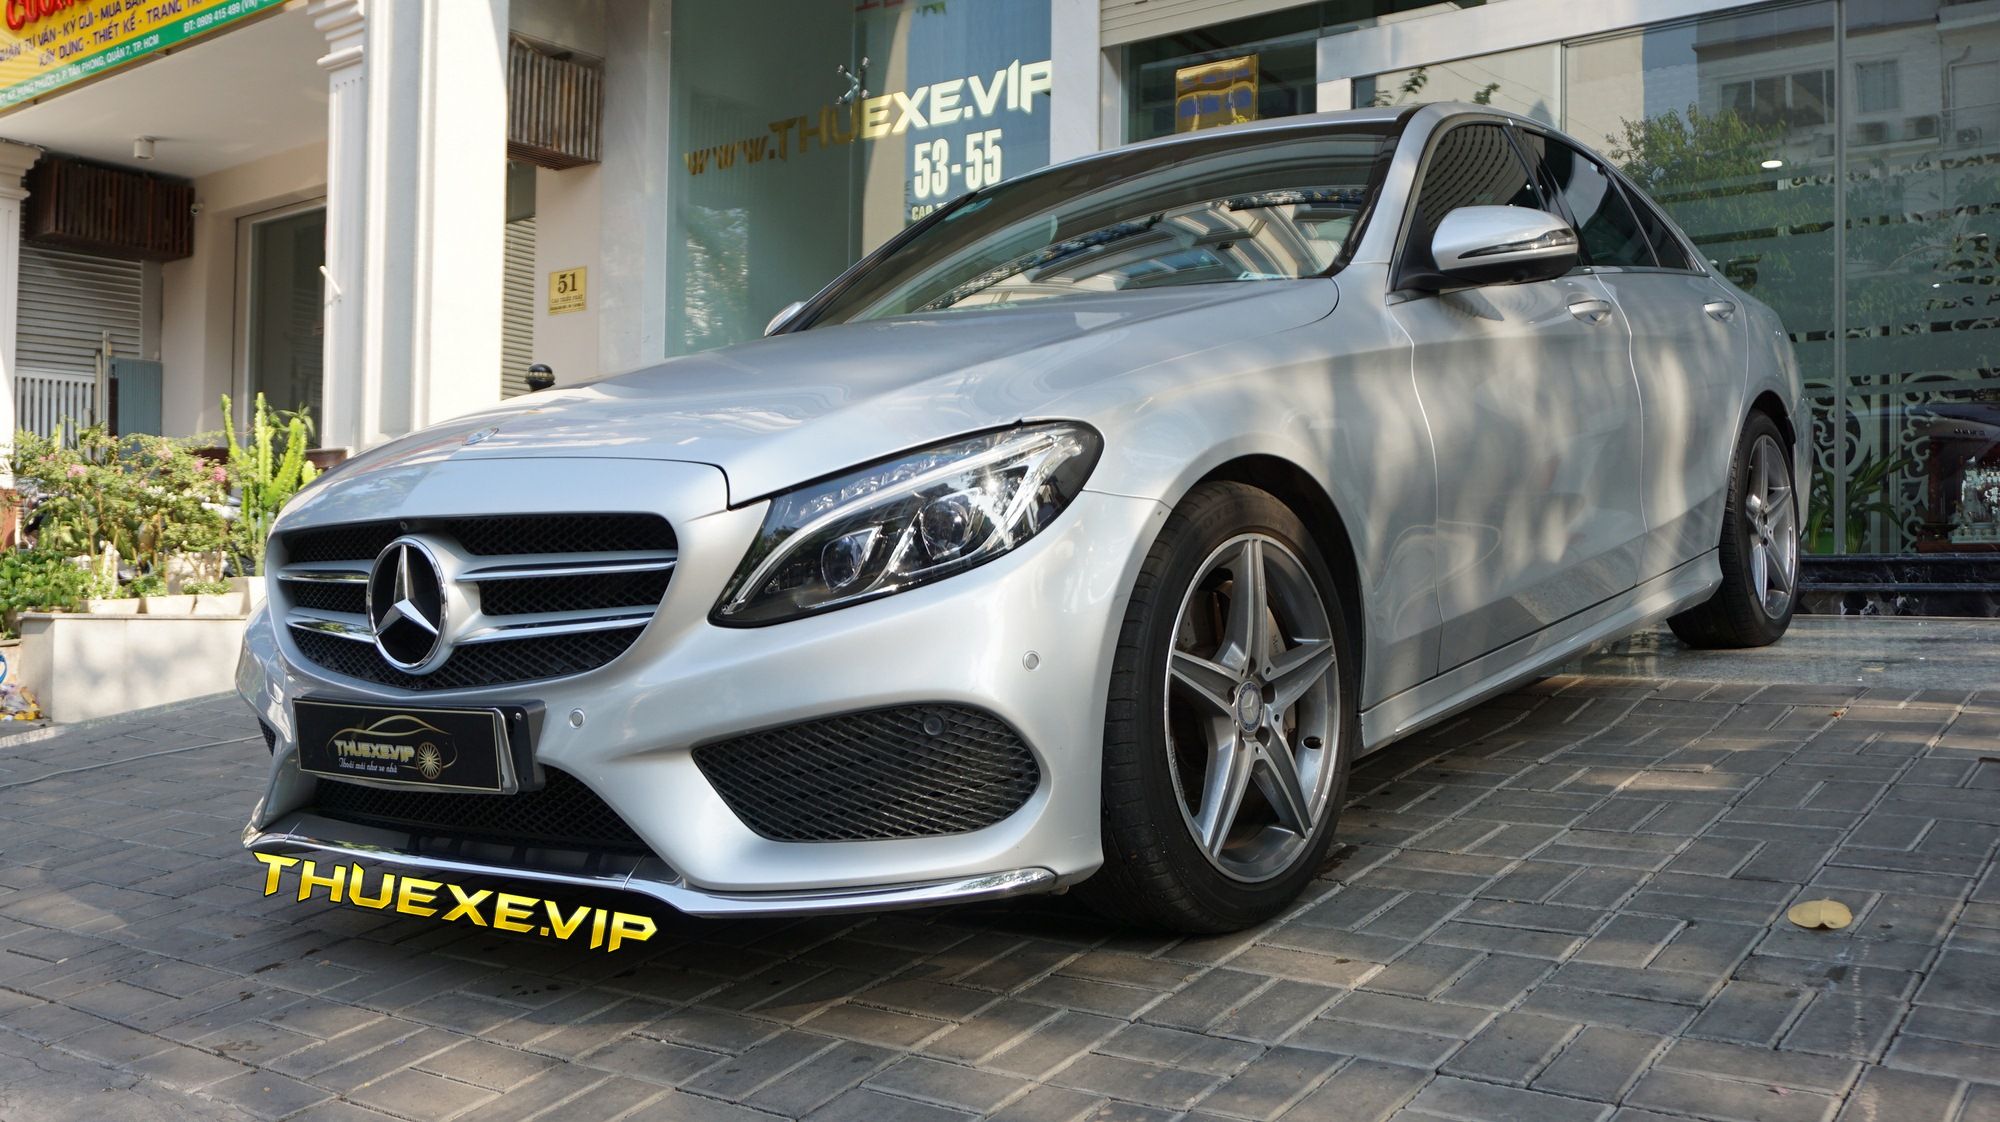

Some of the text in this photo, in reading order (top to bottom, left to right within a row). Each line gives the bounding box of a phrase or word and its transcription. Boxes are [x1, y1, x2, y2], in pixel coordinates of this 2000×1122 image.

[100, 0, 121, 20] MUA
[146, 0, 182, 24] TRANG
[557, 272, 577, 294] 51
